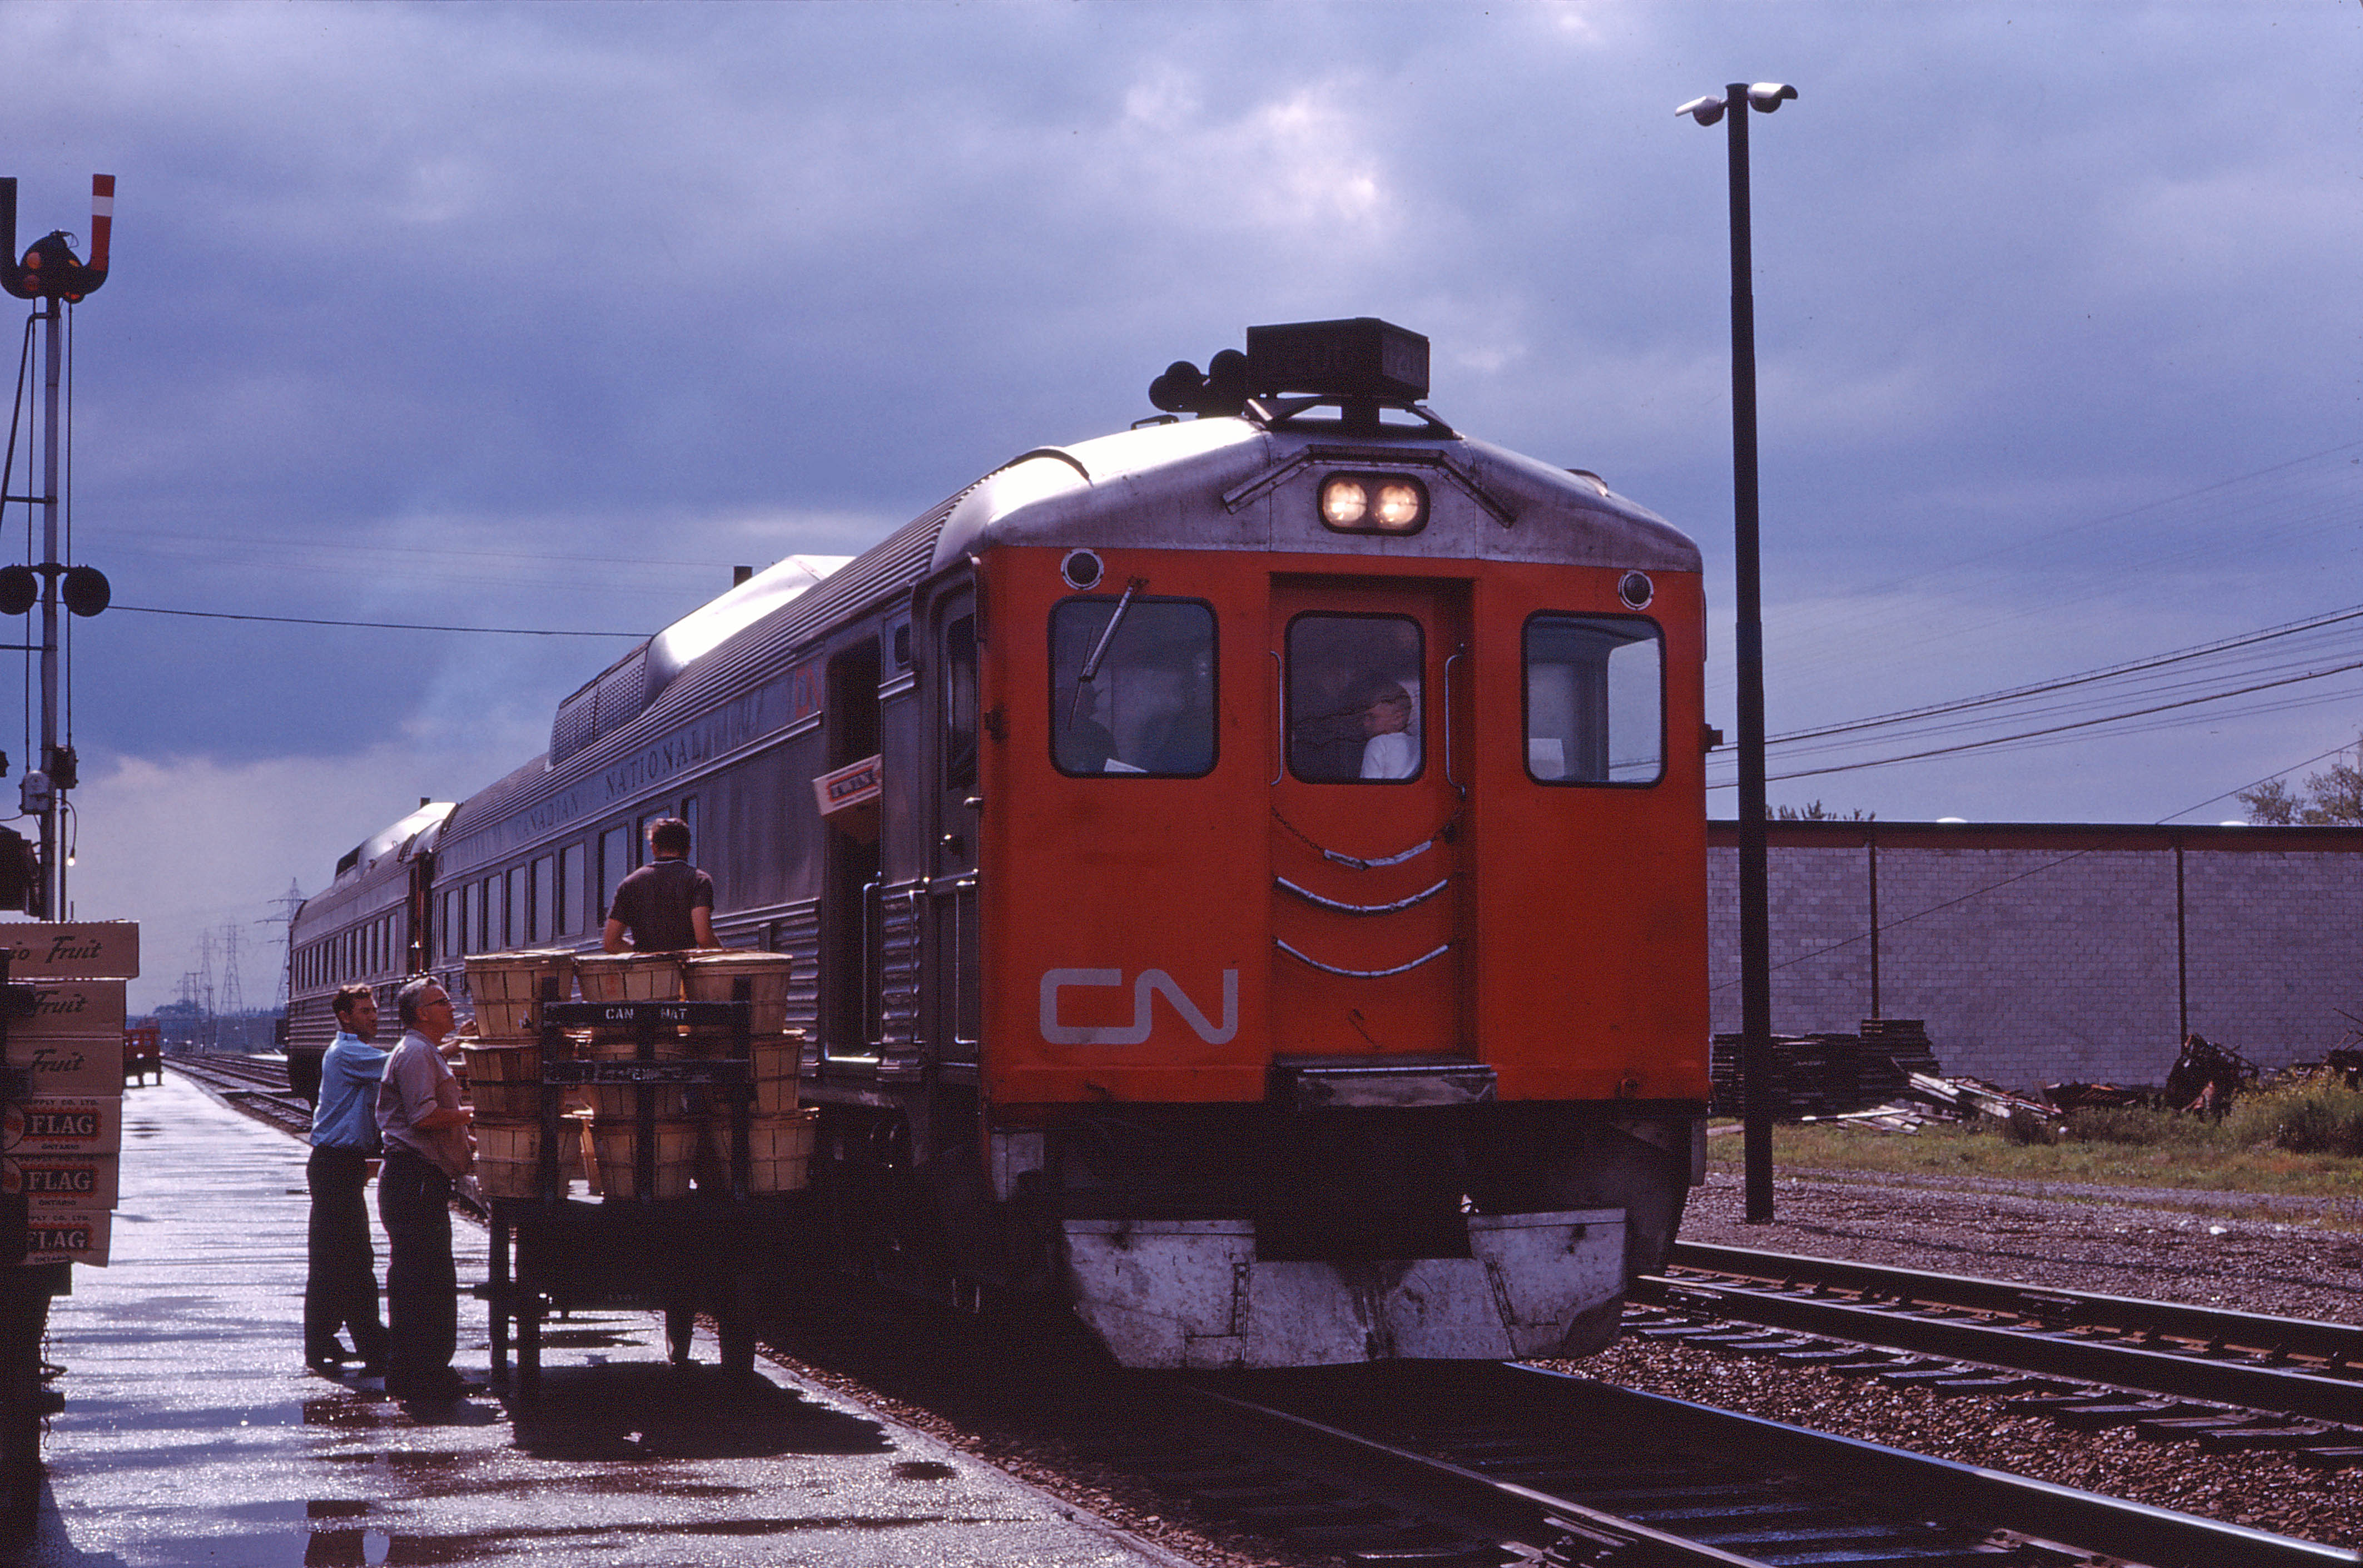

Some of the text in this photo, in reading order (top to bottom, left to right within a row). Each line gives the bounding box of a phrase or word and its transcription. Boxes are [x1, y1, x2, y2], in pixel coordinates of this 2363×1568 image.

[795, 657, 822, 719] CN
[605, 731, 701, 800] NATIONAL
[45, 936, 102, 964] Fruit
[34, 990, 88, 1015] Fruit
[605, 1008, 688, 1020] CAN NAT
[1040, 968, 1238, 1044] CN
[32, 1049, 85, 1073] Fruit
[31, 1115, 94, 1135] FLAG
[28, 1172, 92, 1190] FLAG
